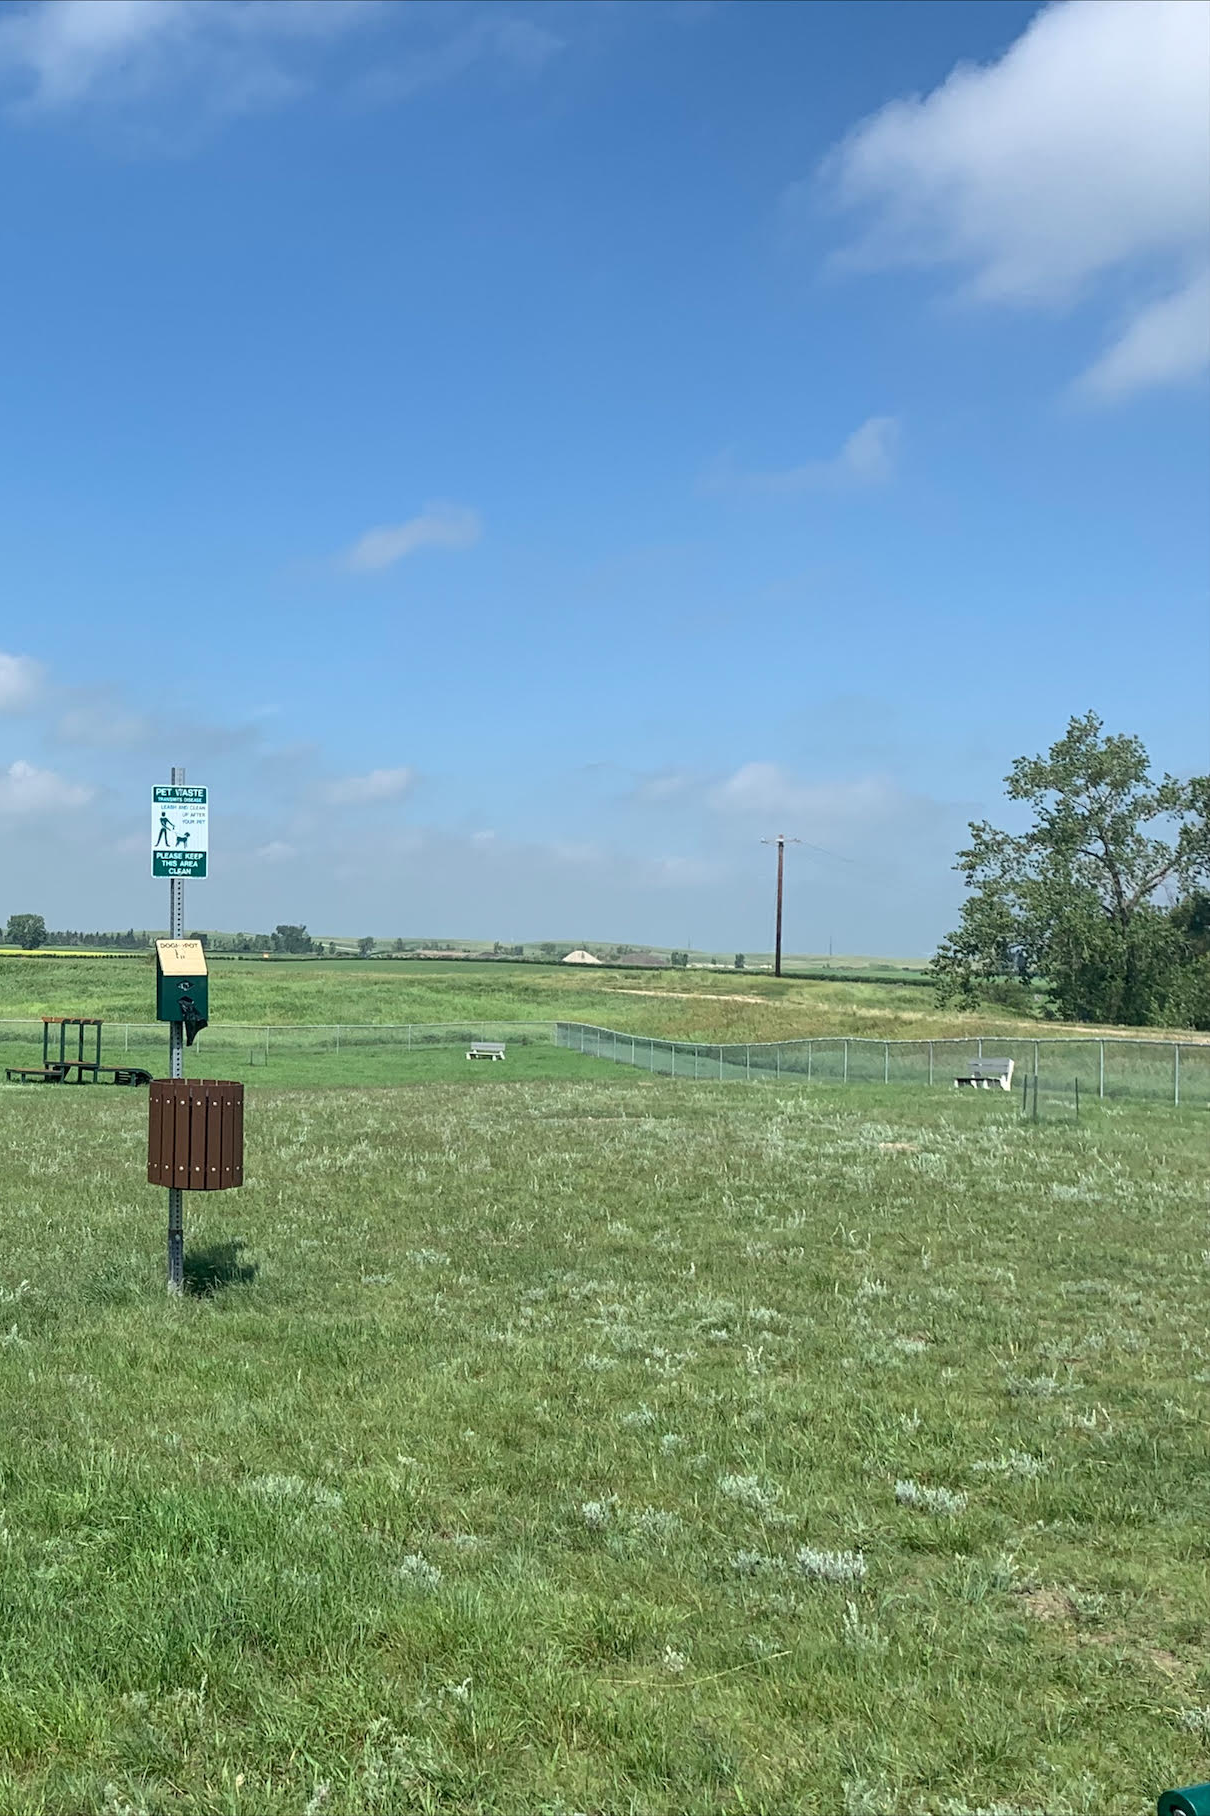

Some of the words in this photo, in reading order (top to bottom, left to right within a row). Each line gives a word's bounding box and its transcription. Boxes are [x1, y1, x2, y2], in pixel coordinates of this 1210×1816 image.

[156, 788, 172, 796] PET
[175, 788, 204, 797] WASTE
[156, 852, 183, 860] PLEASE
[168, 867, 191, 875] CLEAN
